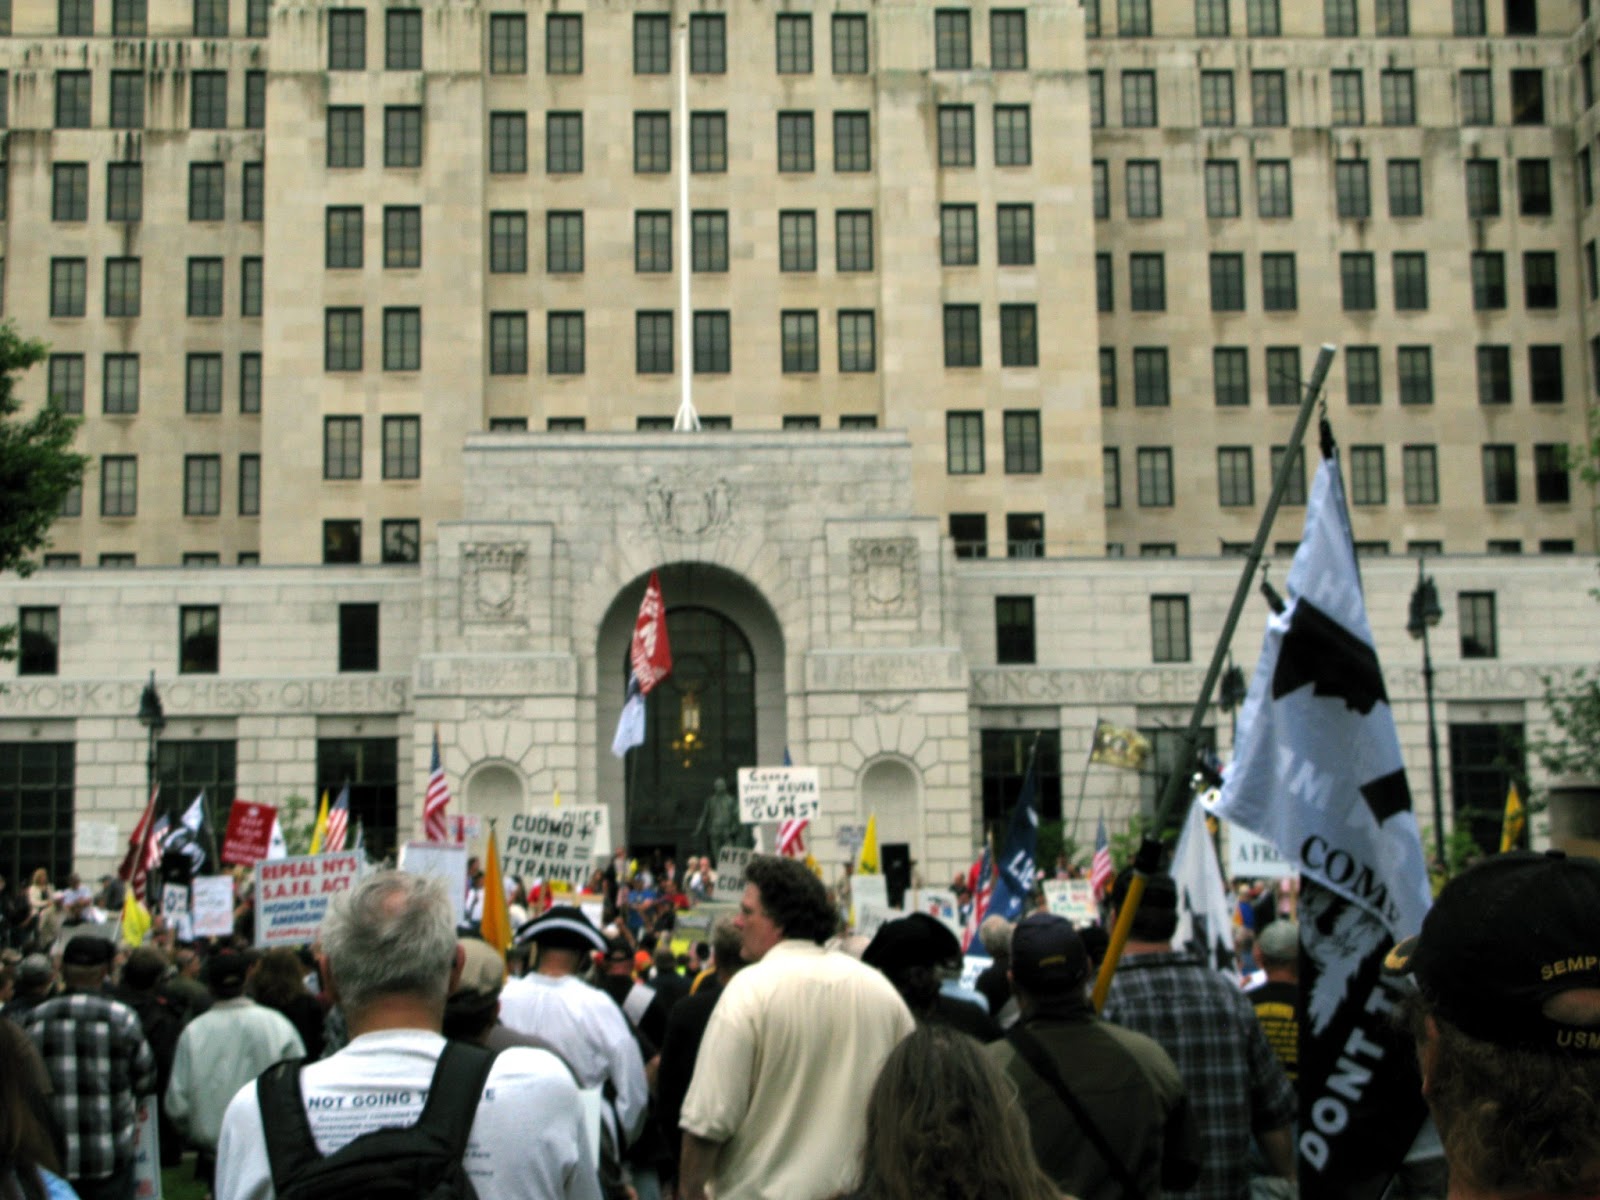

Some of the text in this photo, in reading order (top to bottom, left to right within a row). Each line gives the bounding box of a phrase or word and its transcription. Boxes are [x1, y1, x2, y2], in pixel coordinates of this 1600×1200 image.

[15, 683, 101, 711] YORK
[118, 682, 263, 710] DCHESS
[281, 678, 410, 709] QUEENS
[969, 670, 1065, 698] KINGS
[511, 813, 575, 840] CUOMO
[506, 835, 568, 861] POWER
[261, 861, 317, 881] REPEAL
[320, 876, 350, 894] ACT
[1540, 955, 1600, 980] SEMP
[308, 1096, 346, 1110] NOT
[351, 1091, 412, 1107] GOING
[1299, 1027, 1385, 1172] DONT
